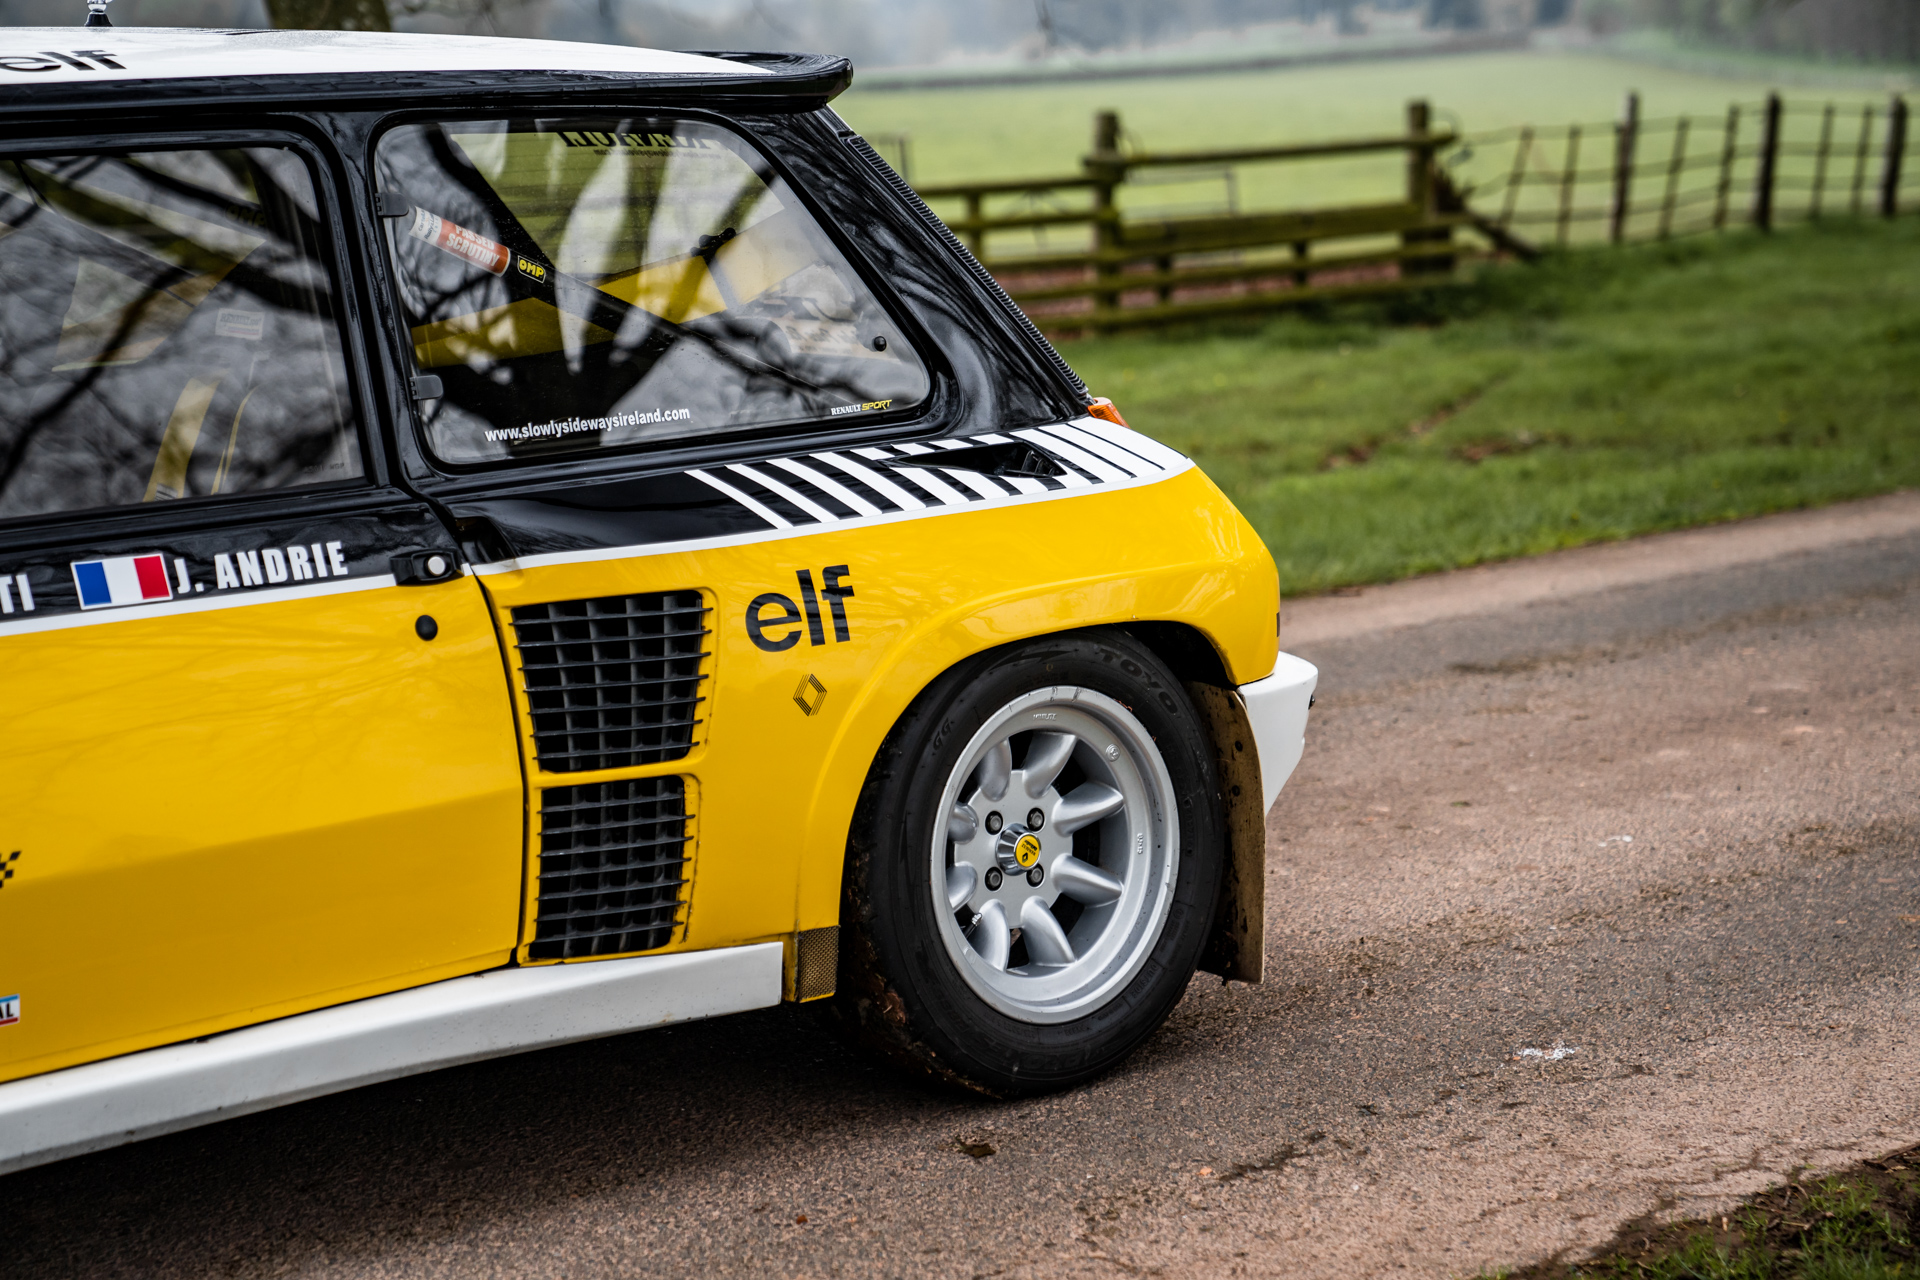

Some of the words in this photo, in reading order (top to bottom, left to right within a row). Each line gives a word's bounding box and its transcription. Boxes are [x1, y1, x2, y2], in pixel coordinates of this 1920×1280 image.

[0, 50, 127, 72] elf
[446, 232, 501, 267] SCRUTINY
[454, 224, 495, 251] PASSED
[519, 259, 545, 278] OMP
[484, 407, 691, 443] www.slowlysidewaysireland.com
[830, 403, 861, 416] RENAULT
[861, 399, 893, 411] SPORT
[173, 558, 205, 594] J.
[214, 541, 349, 590] ANDRIE
[745, 564, 855, 653] elf
[1099, 646, 1179, 715] TOYO
